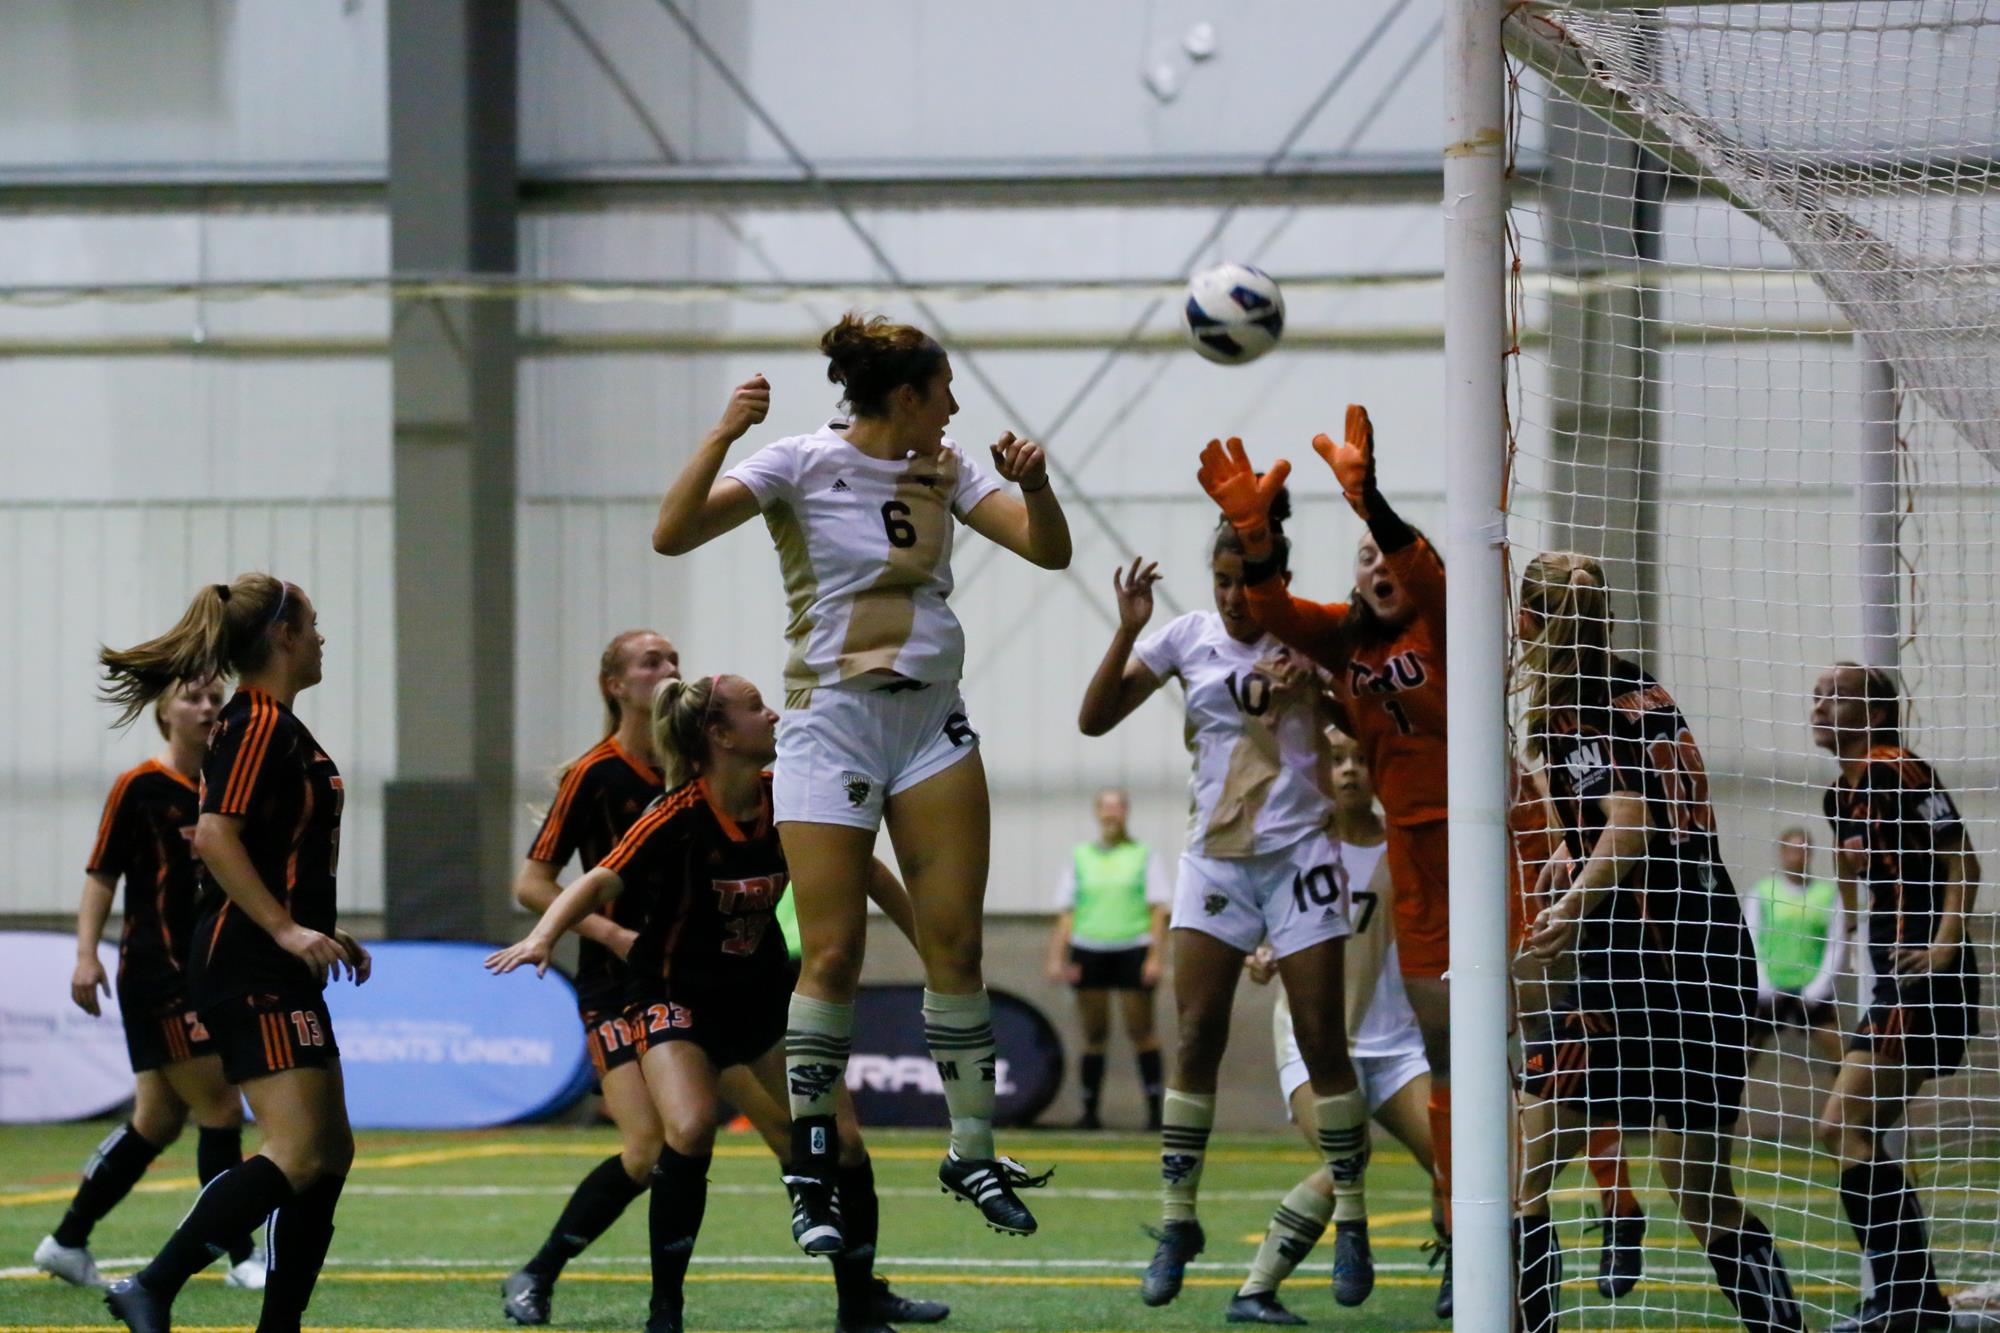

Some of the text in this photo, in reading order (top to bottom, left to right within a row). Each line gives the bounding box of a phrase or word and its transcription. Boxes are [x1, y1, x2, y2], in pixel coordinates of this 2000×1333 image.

[881, 500, 917, 548] 6
[1225, 671, 1271, 717] 10
[943, 712, 979, 748] 6
[1384, 699, 1413, 735] 1
[1293, 864, 1341, 914] 10
[1351, 891, 1378, 934] 7
[290, 1009, 325, 1047] 13
[598, 1017, 632, 1053] 11
[647, 1001, 692, 1034] 23
